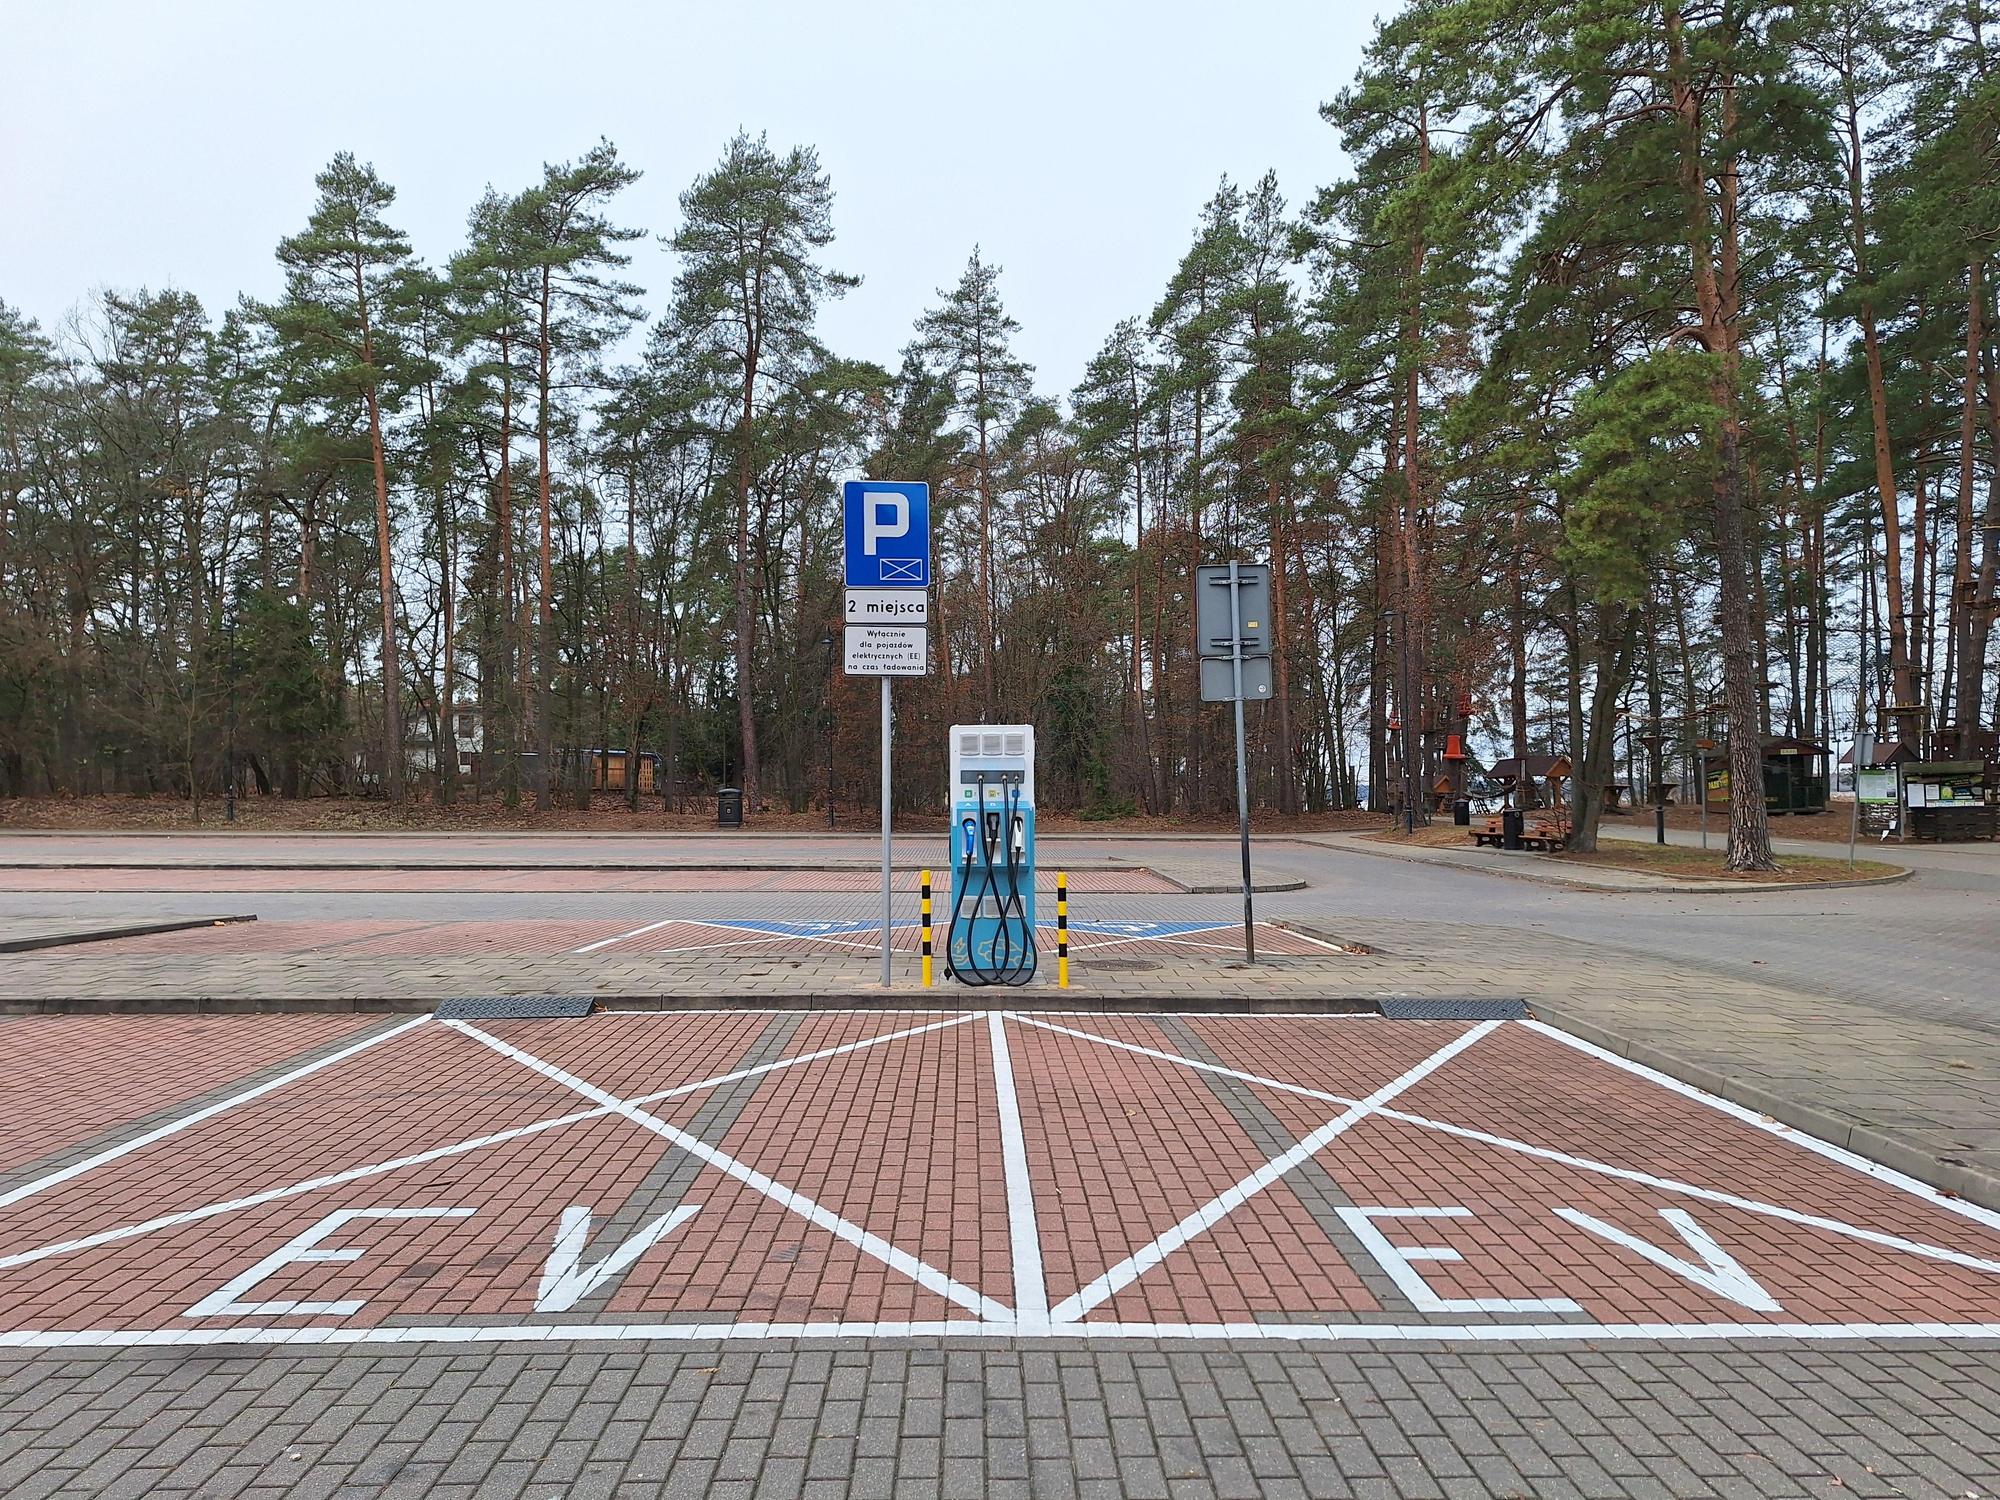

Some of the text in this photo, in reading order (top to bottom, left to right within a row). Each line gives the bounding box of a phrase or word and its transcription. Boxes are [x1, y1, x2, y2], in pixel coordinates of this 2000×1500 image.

[864, 492, 910, 556] P
[848, 600, 925, 616] 2 miejsca
[852, 652, 921, 661] elektrycznych (EE)
